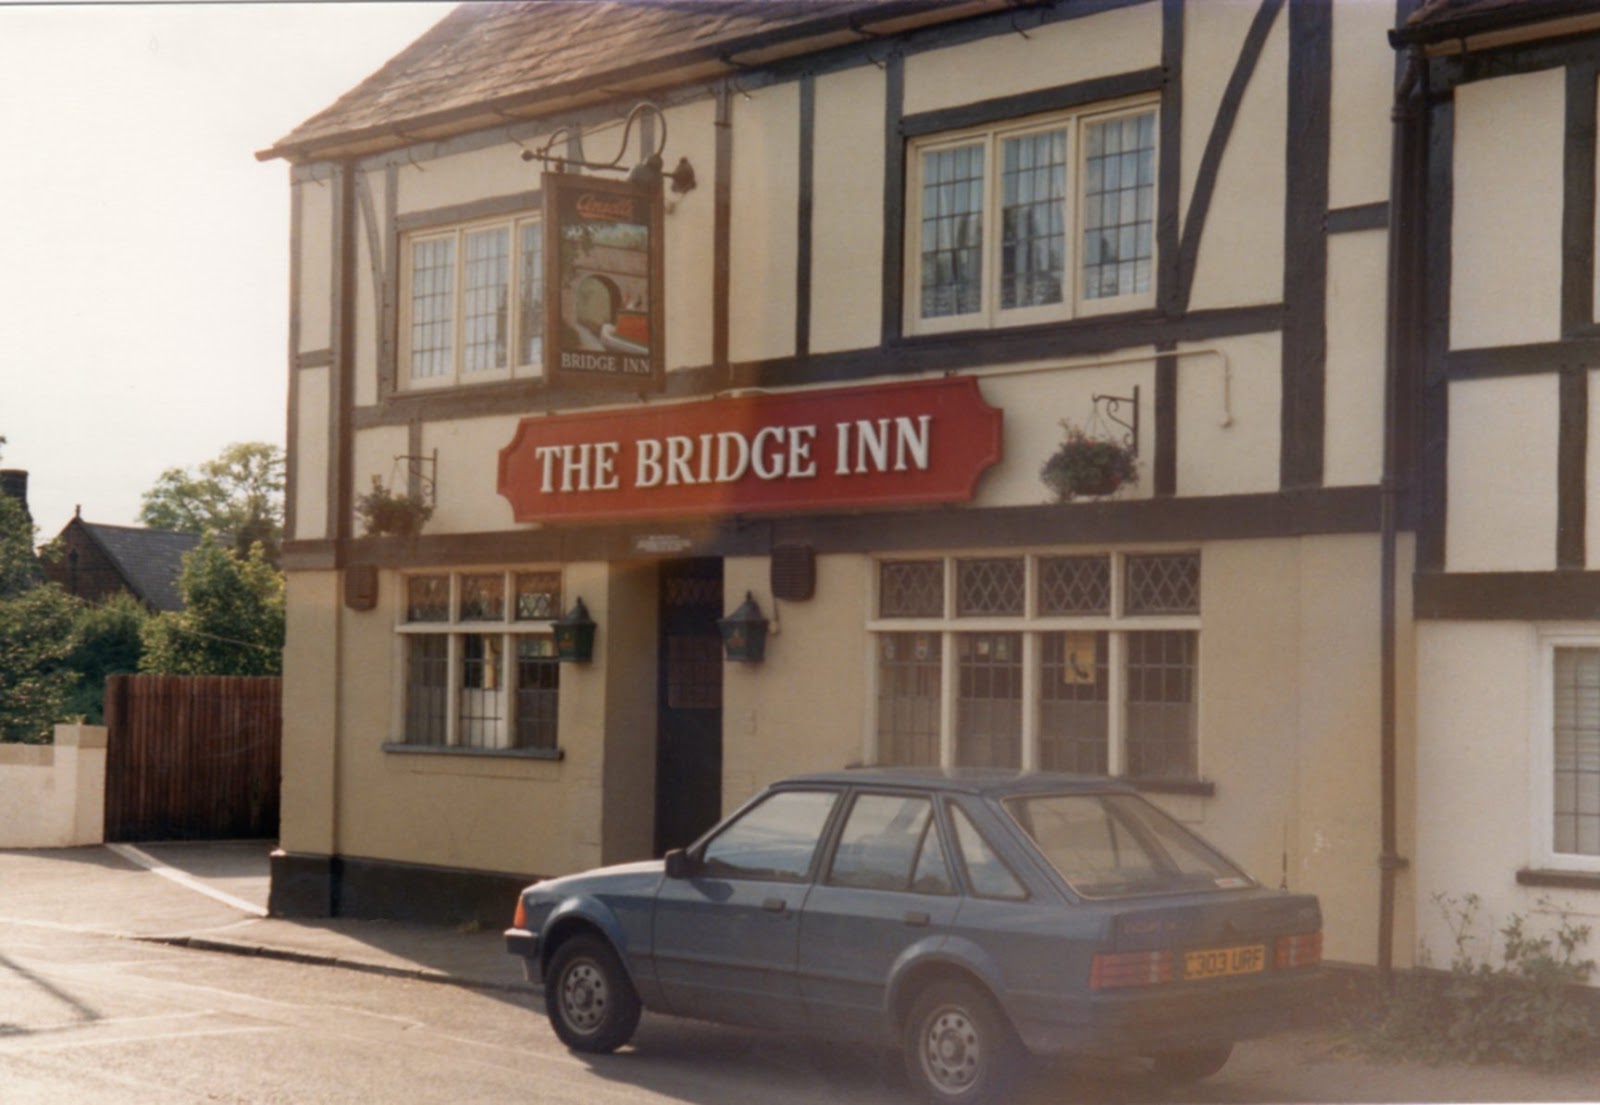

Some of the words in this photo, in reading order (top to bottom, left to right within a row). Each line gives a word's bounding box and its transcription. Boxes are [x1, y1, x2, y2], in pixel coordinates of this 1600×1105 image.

[561, 352, 616, 372] BRIDGE
[623, 357, 650, 374] INN
[535, 441, 620, 494] THE
[634, 425, 818, 488] BRIDGE
[834, 415, 932, 476] INN
